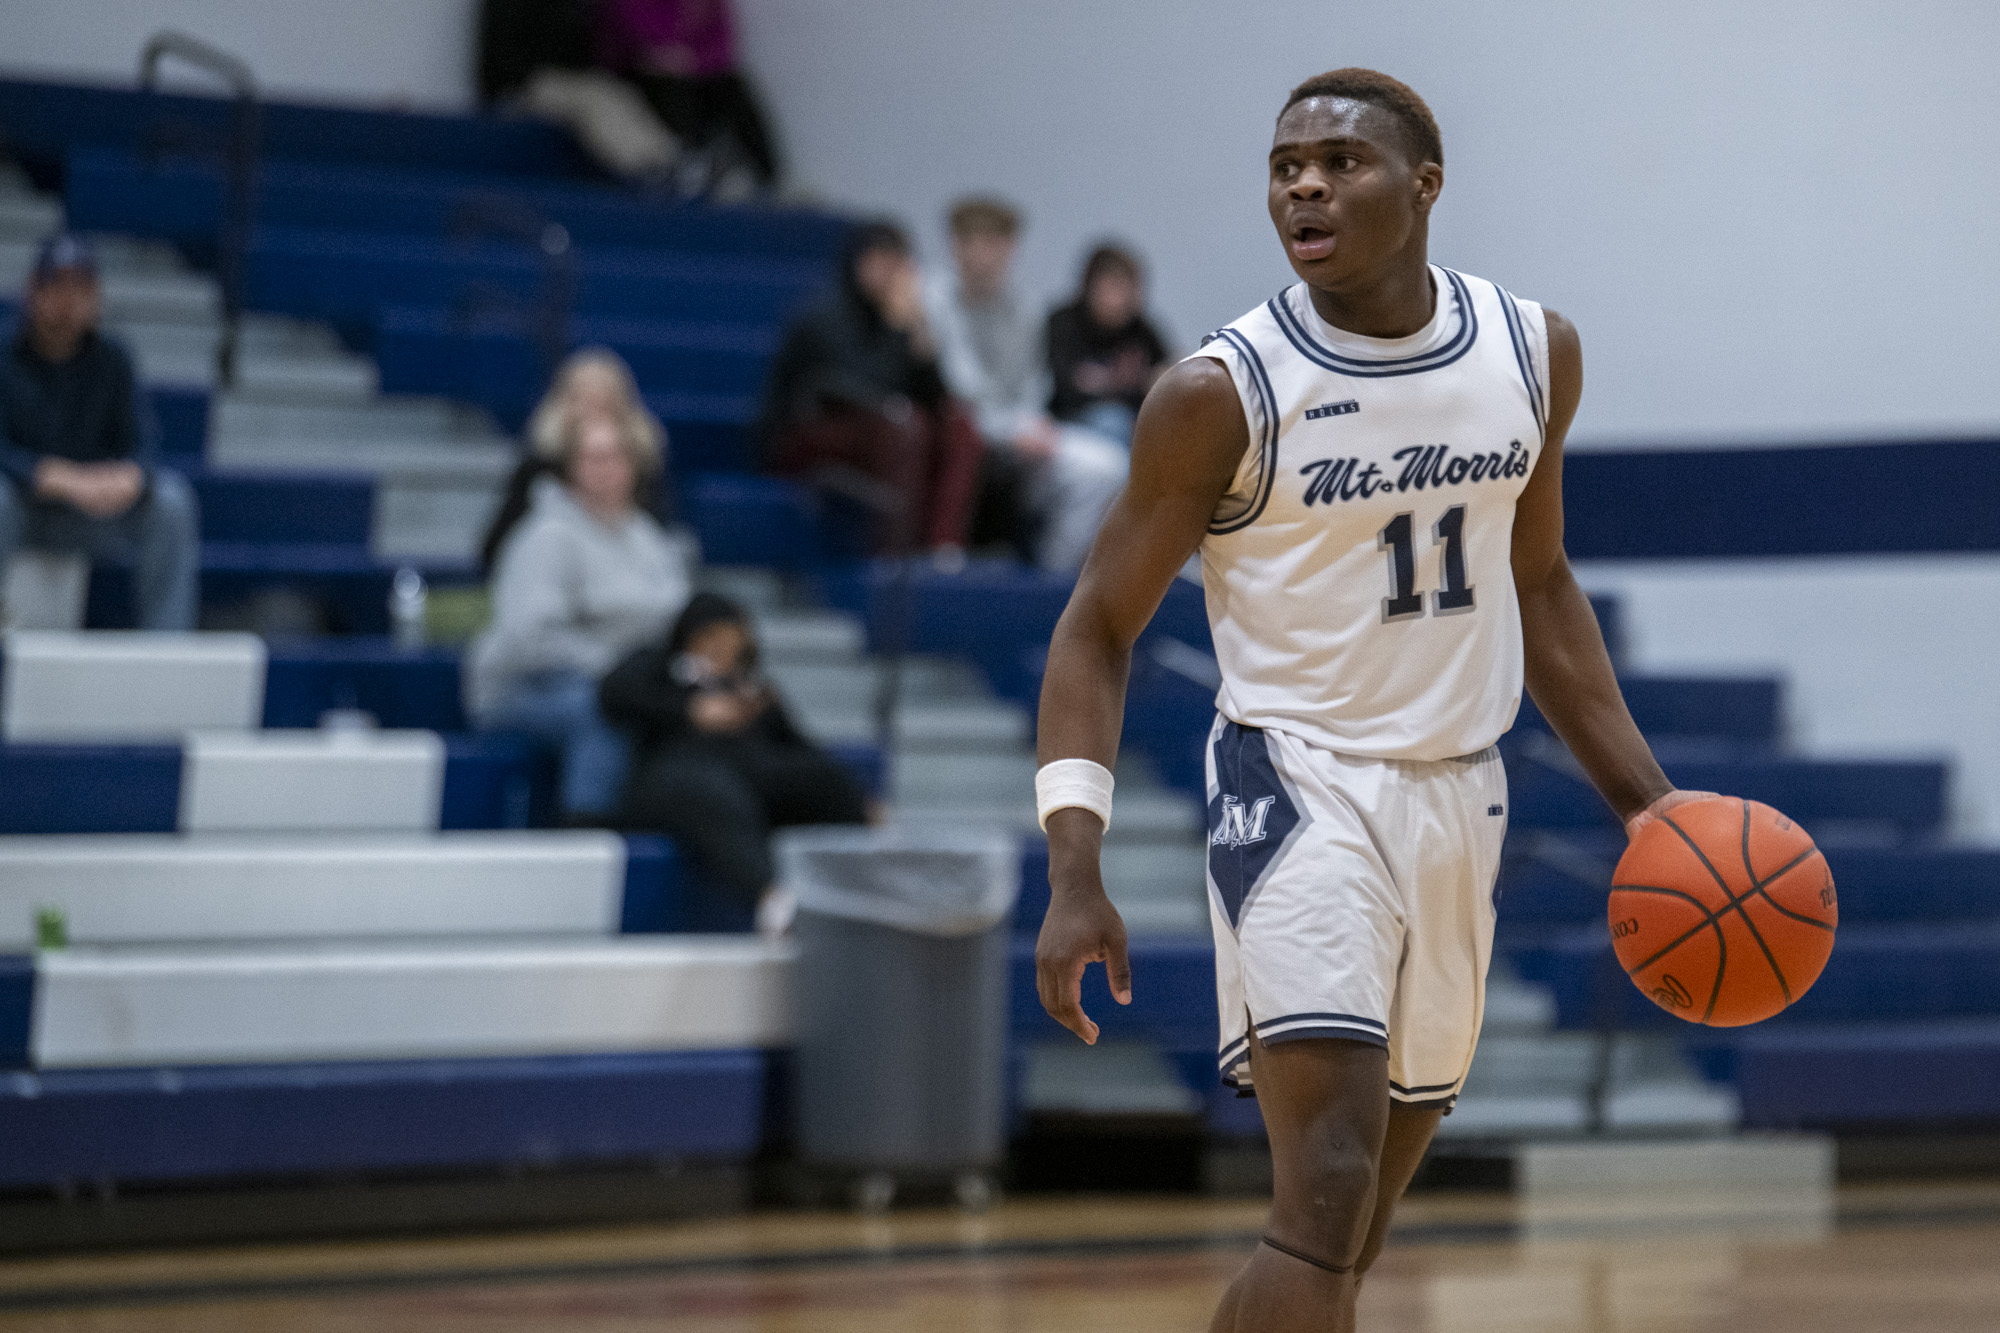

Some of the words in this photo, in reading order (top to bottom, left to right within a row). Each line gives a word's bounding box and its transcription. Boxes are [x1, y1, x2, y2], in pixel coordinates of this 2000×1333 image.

[1299, 457, 1393, 508] Mt.
[1392, 439, 1530, 492] Morris
[1377, 502, 1477, 624] 11
